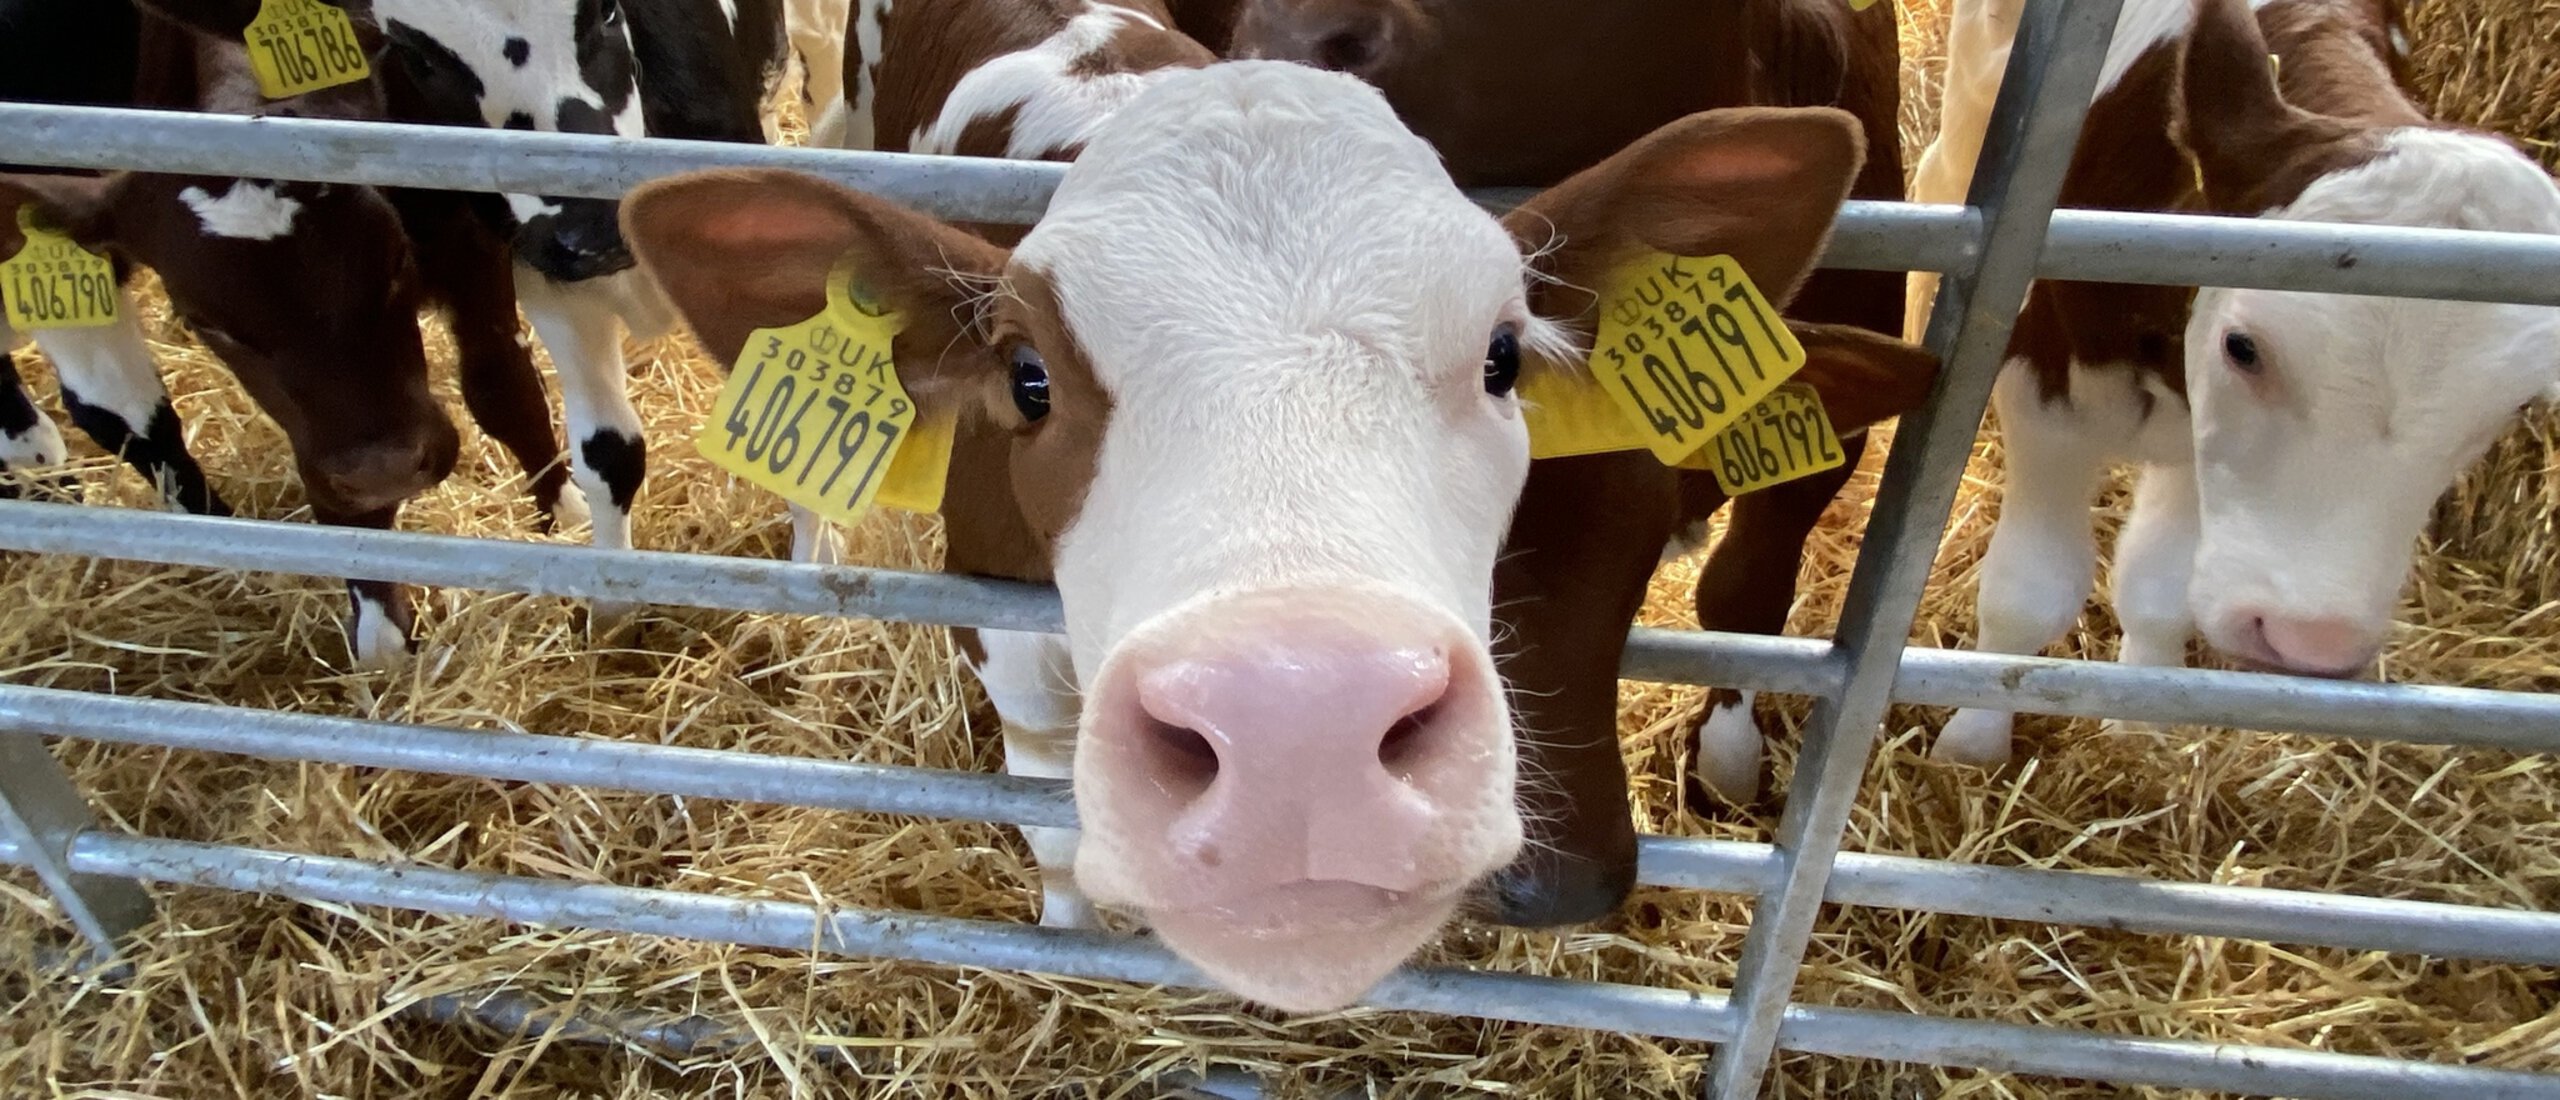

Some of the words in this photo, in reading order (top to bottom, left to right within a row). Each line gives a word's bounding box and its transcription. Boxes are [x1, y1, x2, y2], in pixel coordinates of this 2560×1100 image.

[254, 9, 338, 38] 303879
[284, 0, 317, 15] UK
[260, 22, 361, 88] 706786
[10, 260, 104, 275] 303879
[48, 245, 81, 260] UK
[14, 272, 113, 322] 406790
[1635, 255, 1693, 307] UK
[1605, 266, 1726, 370] 303879
[762, 336, 908, 418] 303879
[838, 338, 893, 383] UK
[1620, 282, 1789, 443] 406797
[725, 362, 900, 510] 406797
[1716, 405, 1837, 487] 606792
